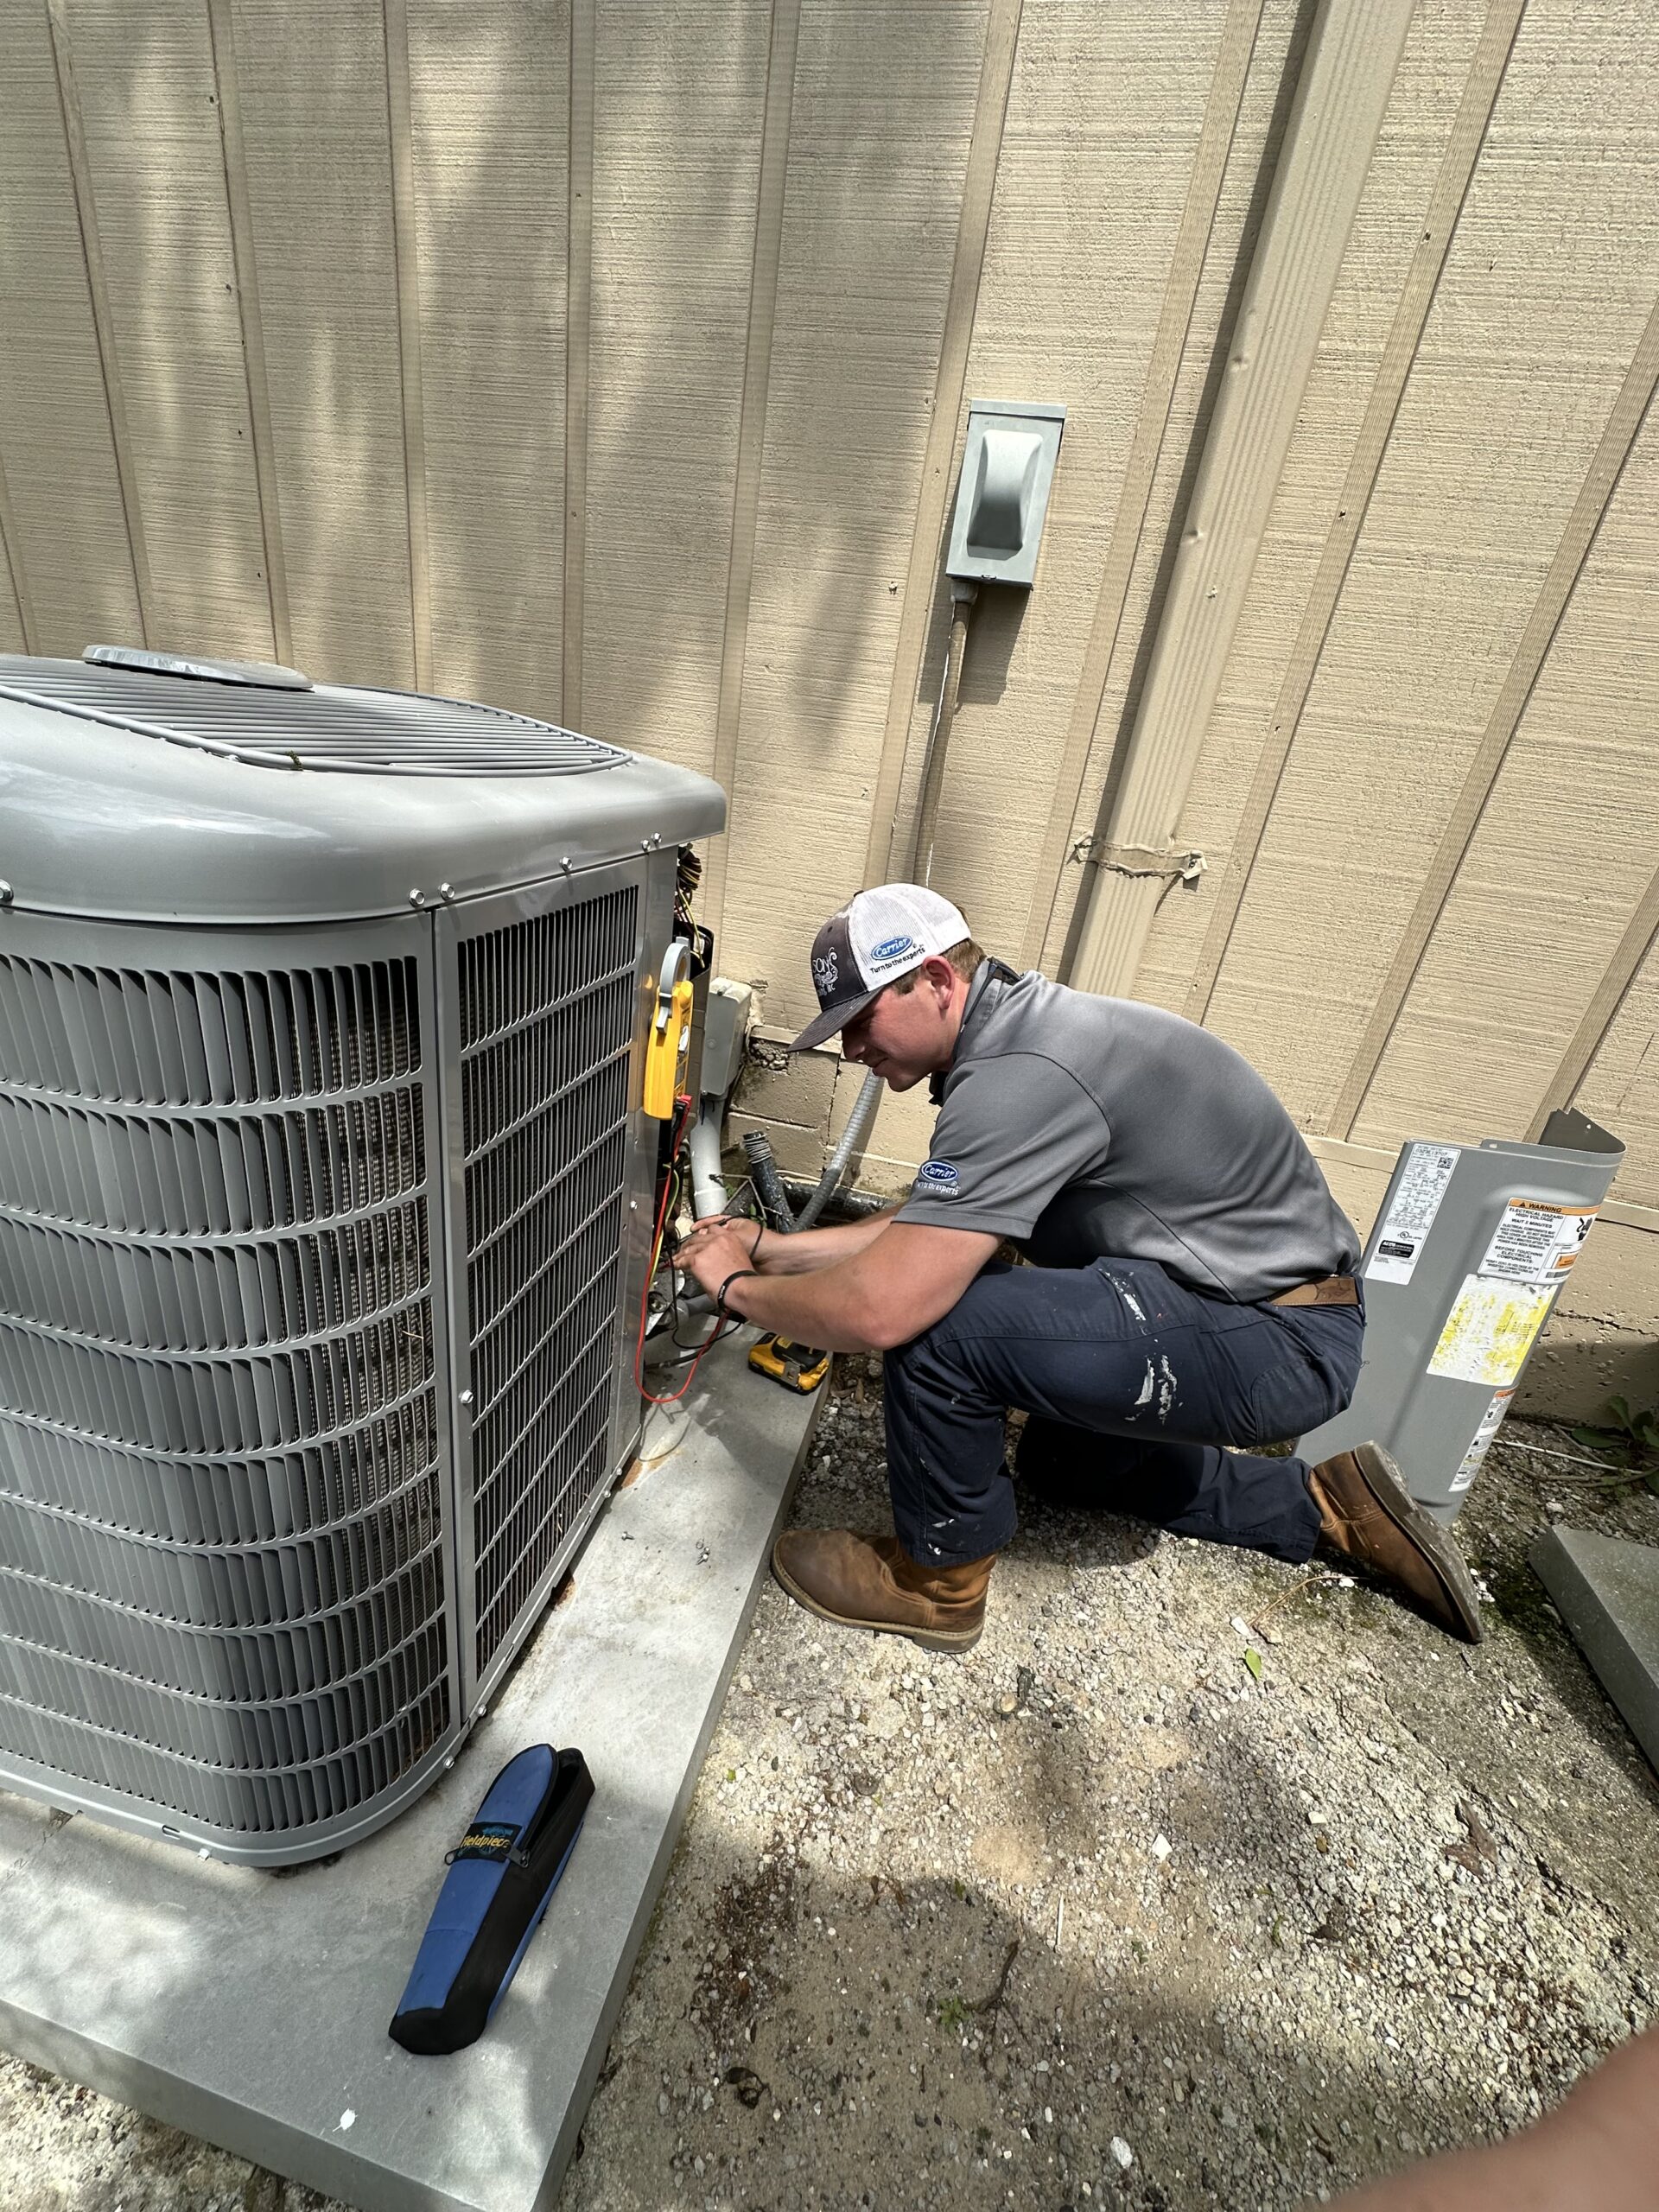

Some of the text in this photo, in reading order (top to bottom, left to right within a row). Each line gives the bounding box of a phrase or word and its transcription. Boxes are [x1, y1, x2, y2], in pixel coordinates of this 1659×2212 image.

[876, 938, 907, 957] Carrier
[869, 965, 886, 974] Turn
[902, 947, 925, 961] experts
[924, 1164, 956, 1178] Carrier
[936, 1184, 959, 1195] experts
[1529, 1203, 1562, 1212] WARNING
